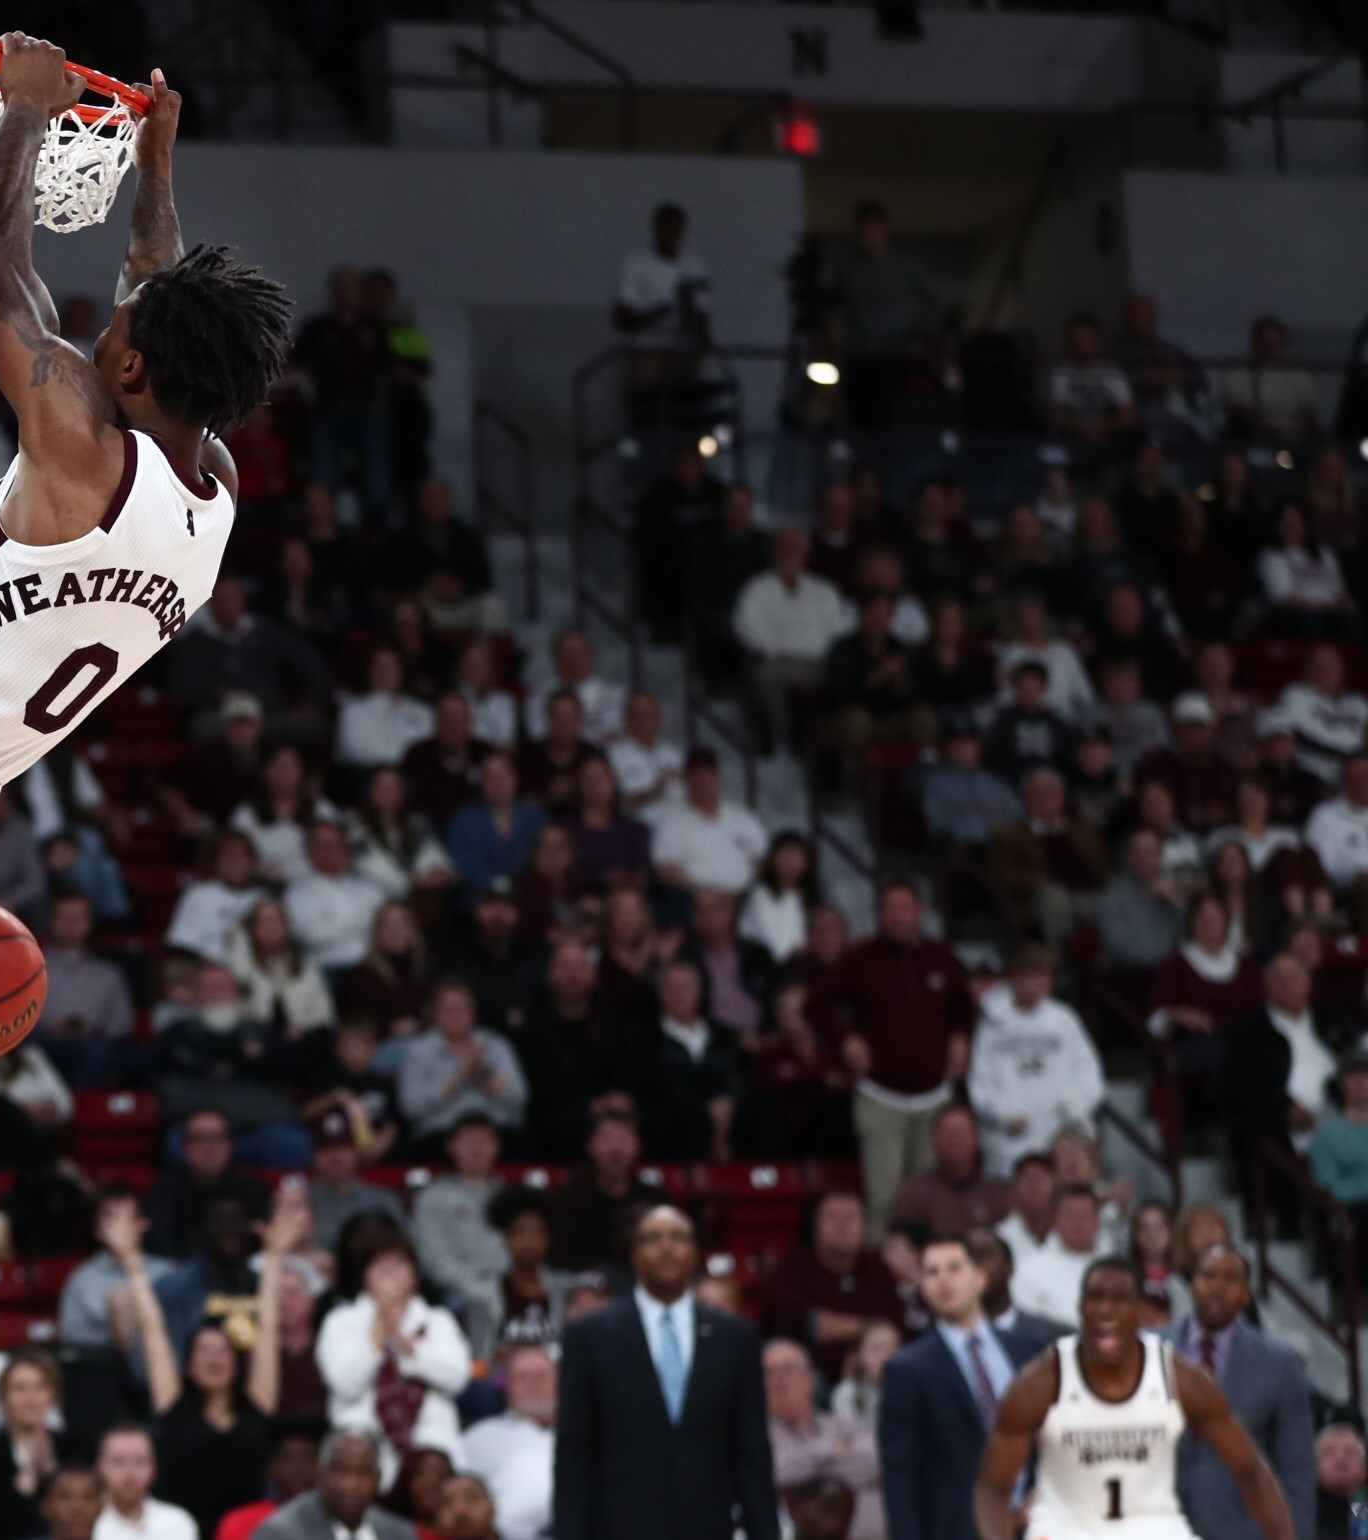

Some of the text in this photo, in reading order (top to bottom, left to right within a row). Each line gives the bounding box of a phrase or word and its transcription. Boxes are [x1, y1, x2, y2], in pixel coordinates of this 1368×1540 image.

[790, 26, 828, 79] N
[23, 642, 119, 735] 0
[1103, 1477, 1124, 1520] 1
